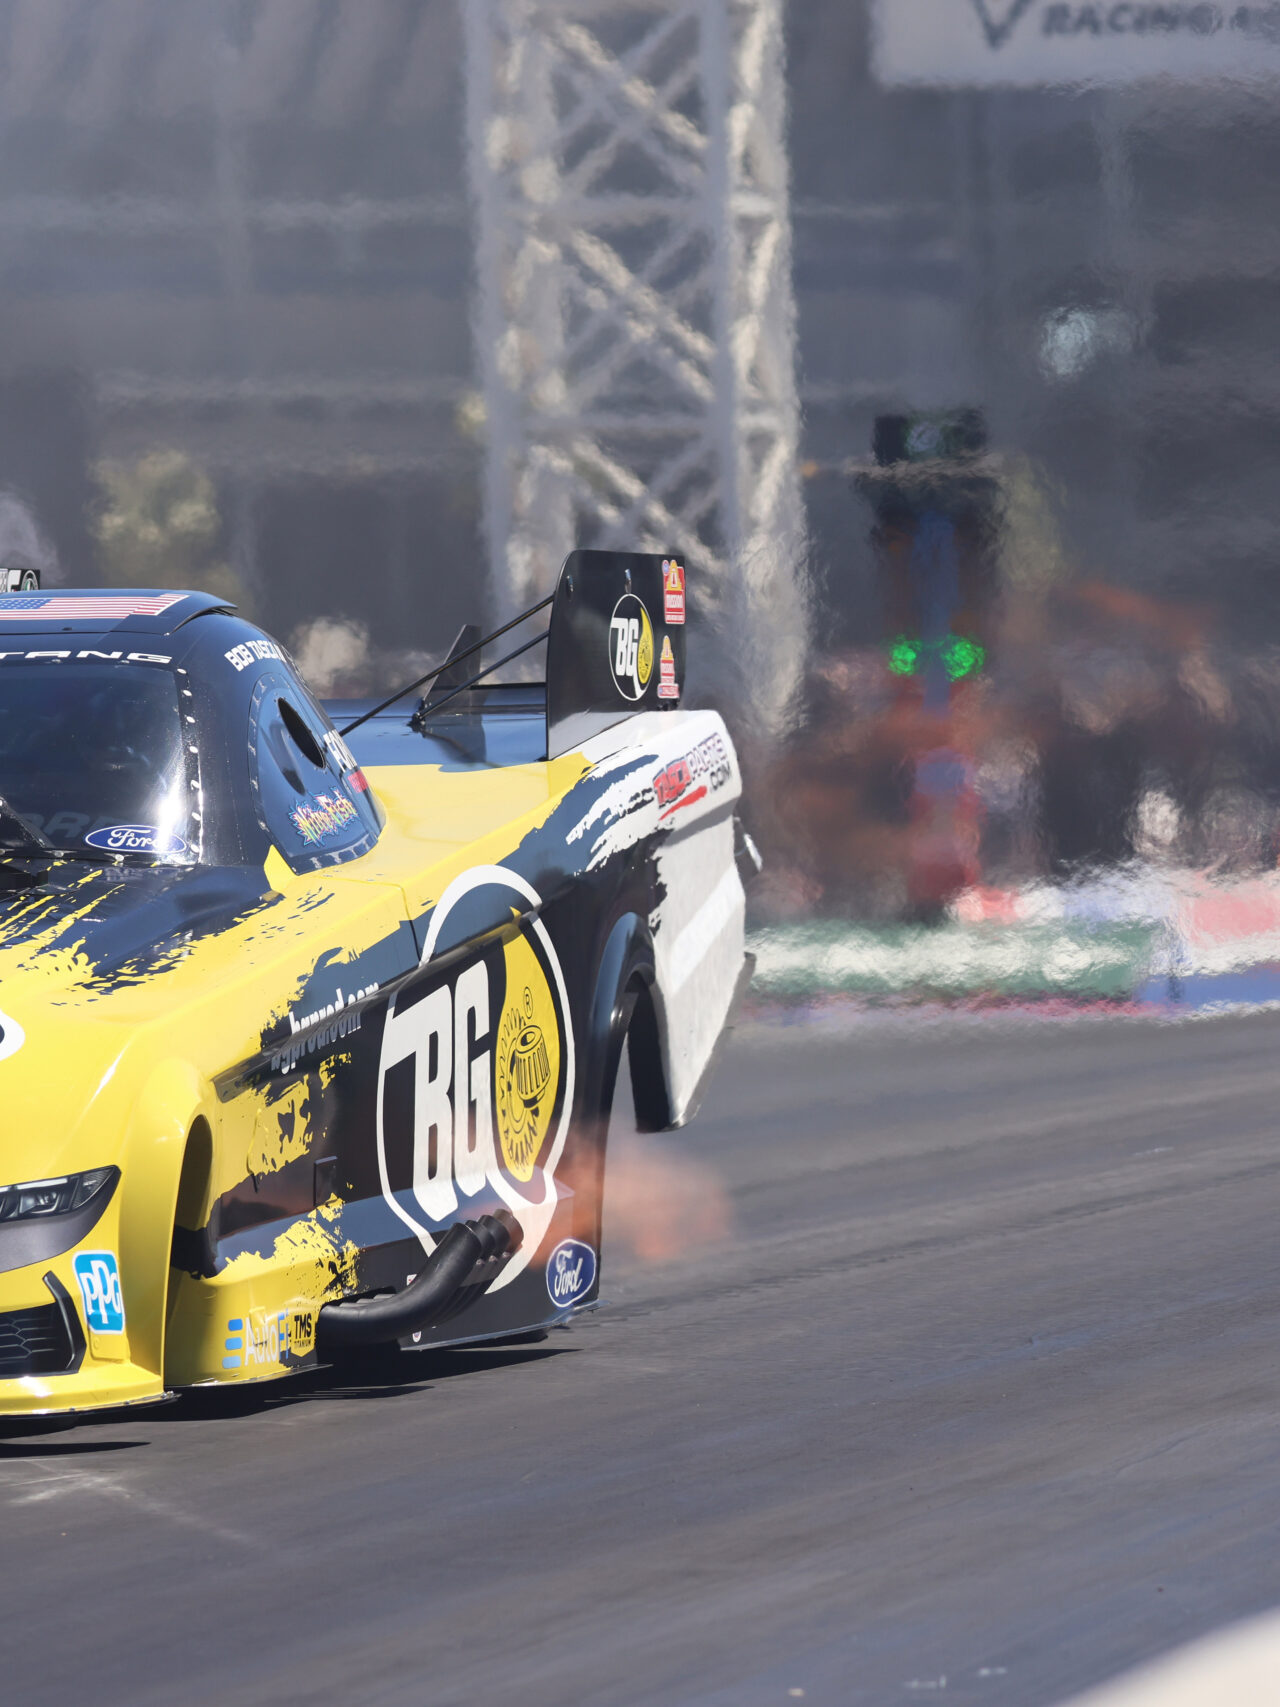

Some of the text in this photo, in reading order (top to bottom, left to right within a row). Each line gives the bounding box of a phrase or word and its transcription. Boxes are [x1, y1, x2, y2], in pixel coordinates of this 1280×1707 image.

[224, 644, 255, 671] BOB
[610, 617, 639, 677] BG
[384, 959, 491, 1222] BG
[84, 1260, 121, 1324] PPG
[554, 1250, 584, 1294] Ford
[294, 1313, 312, 1339] TMS
